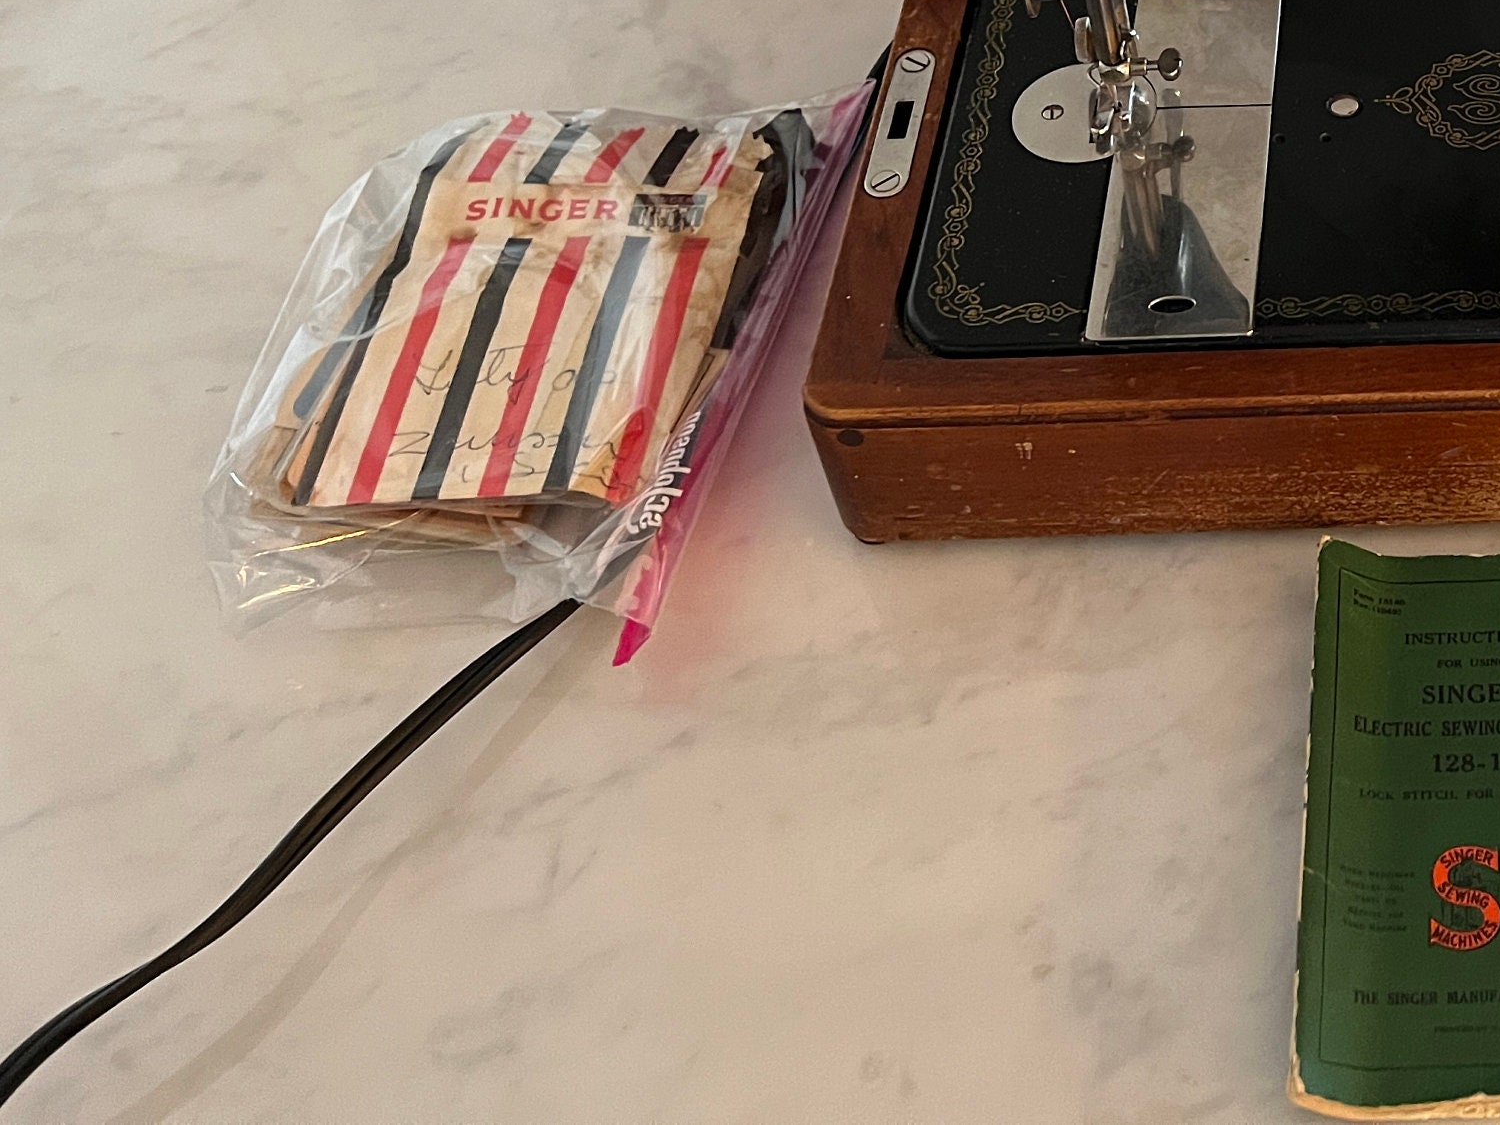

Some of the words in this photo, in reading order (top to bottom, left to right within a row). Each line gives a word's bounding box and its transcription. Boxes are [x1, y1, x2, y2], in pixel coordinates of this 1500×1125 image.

[465, 197, 619, 222] SINGER
[1436, 659, 1463, 669] FOR
[1353, 714, 1432, 737] ELECTRIC
[1359, 788, 1395, 800] LOCK
[1466, 788, 1493, 799] FOR
[1439, 848, 1493, 869] SINGER
[1437, 881, 1490, 908] SEWING
[1432, 920, 1498, 948] MACHINES
[1353, 990, 1379, 1005] THE
[1387, 991, 1438, 1006] SINGER
